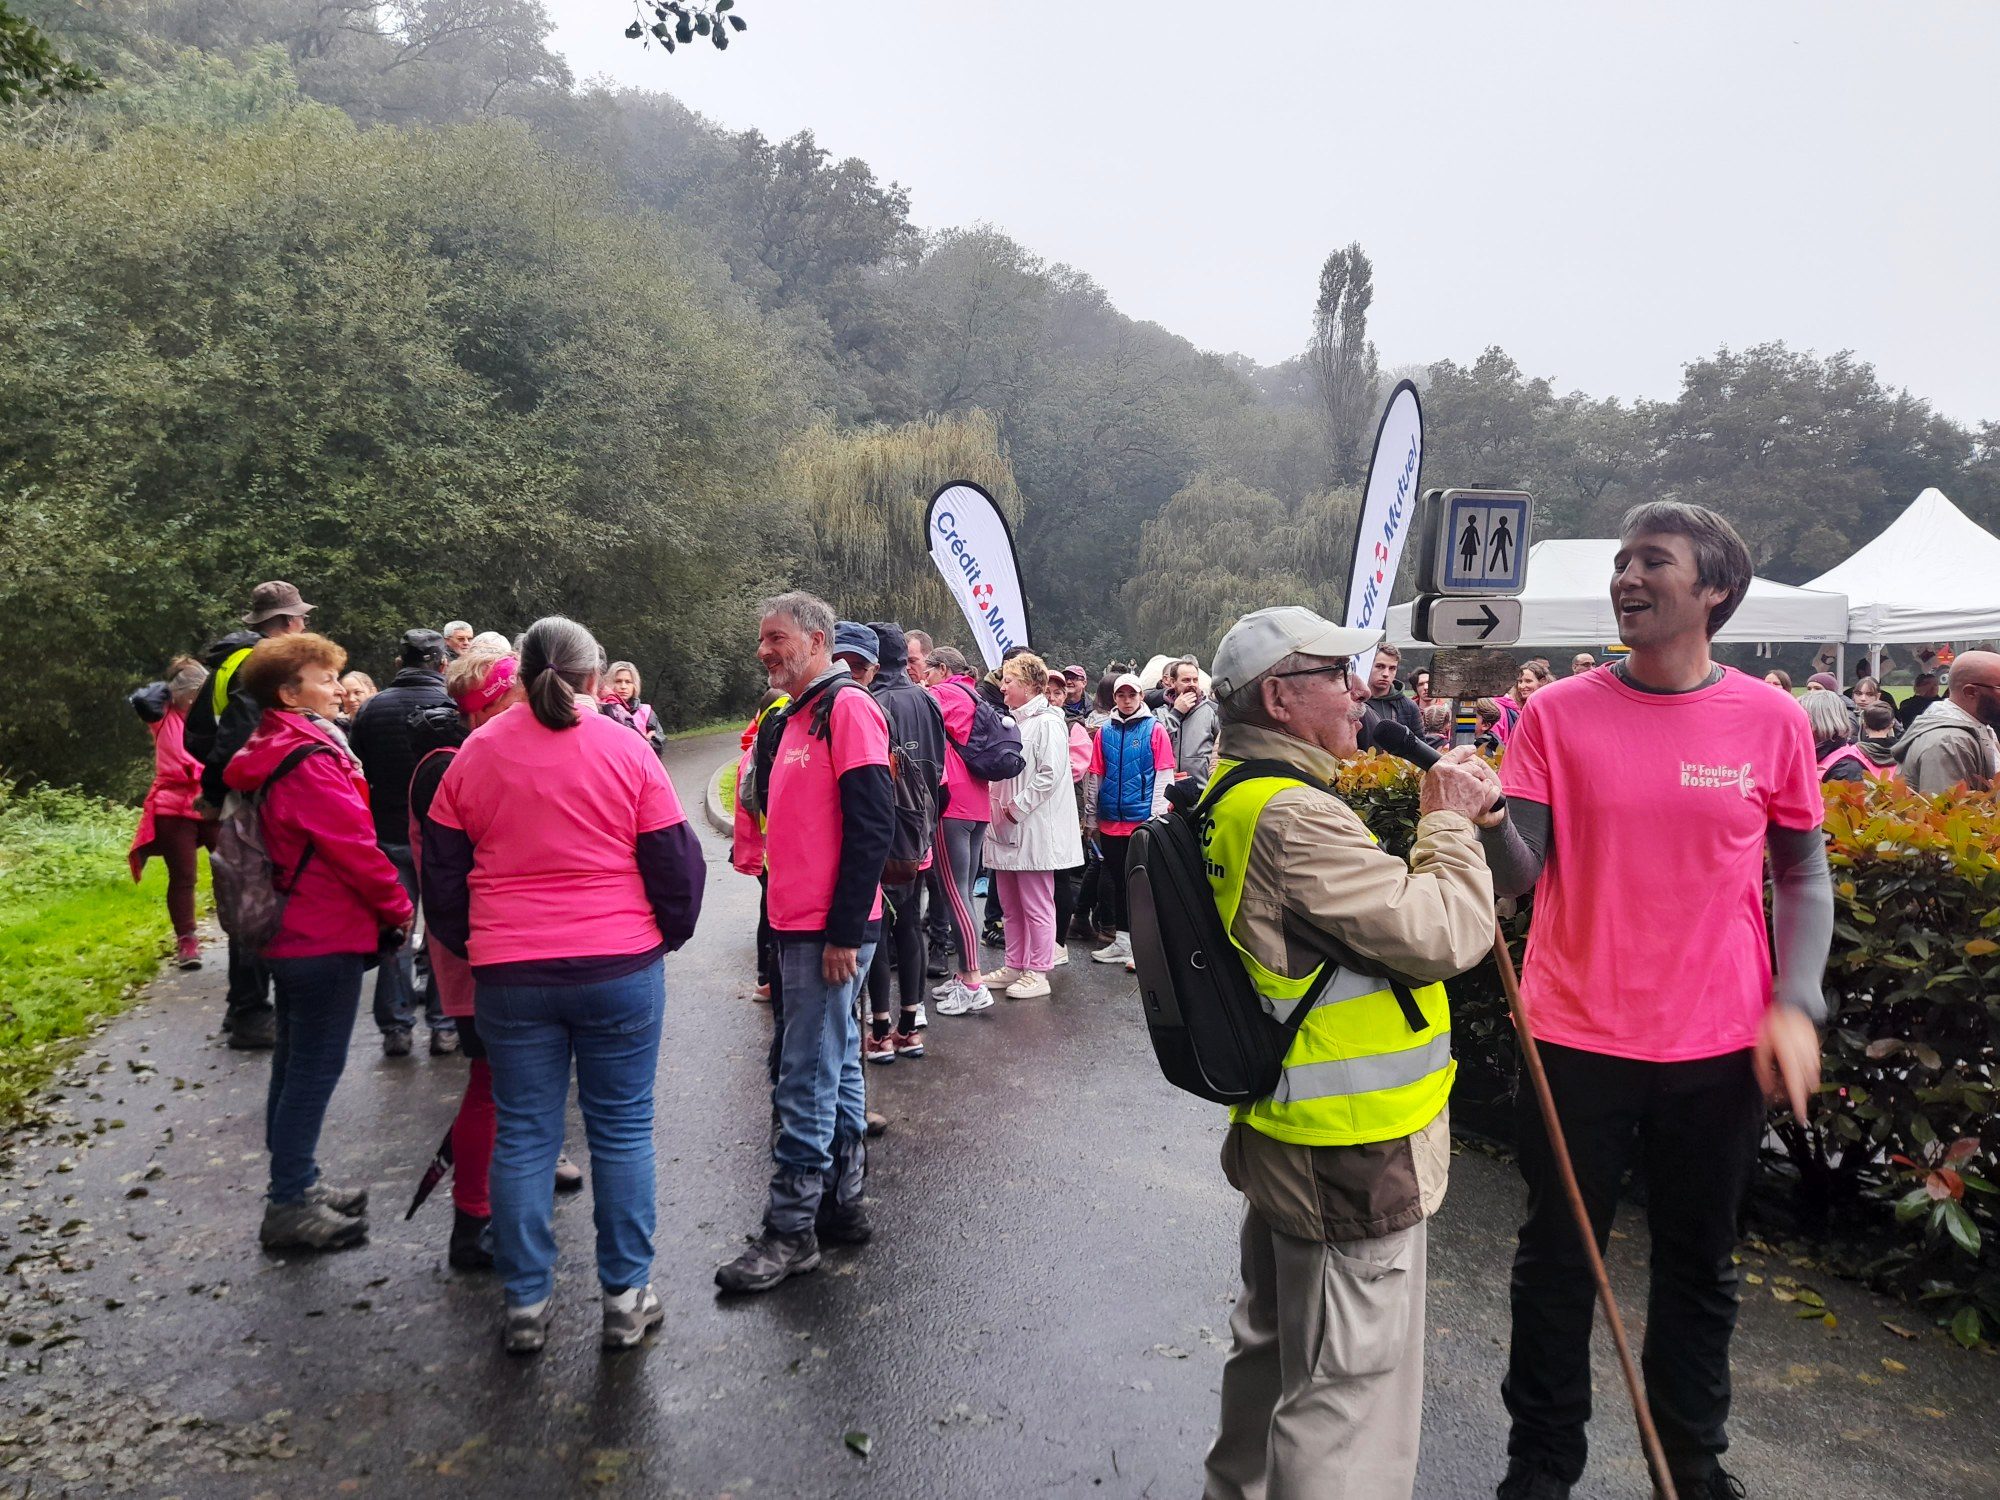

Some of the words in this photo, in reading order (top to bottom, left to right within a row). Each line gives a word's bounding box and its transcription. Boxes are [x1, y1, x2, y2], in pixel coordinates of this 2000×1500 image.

[1383, 433, 1417, 547] Mutuel
[937, 511, 982, 586] Crédit
[985, 604, 1015, 656] Mut
[1680, 760, 1697, 772] Les
[1698, 764, 1739, 778] Foulées
[1680, 771, 1721, 788] Roses
